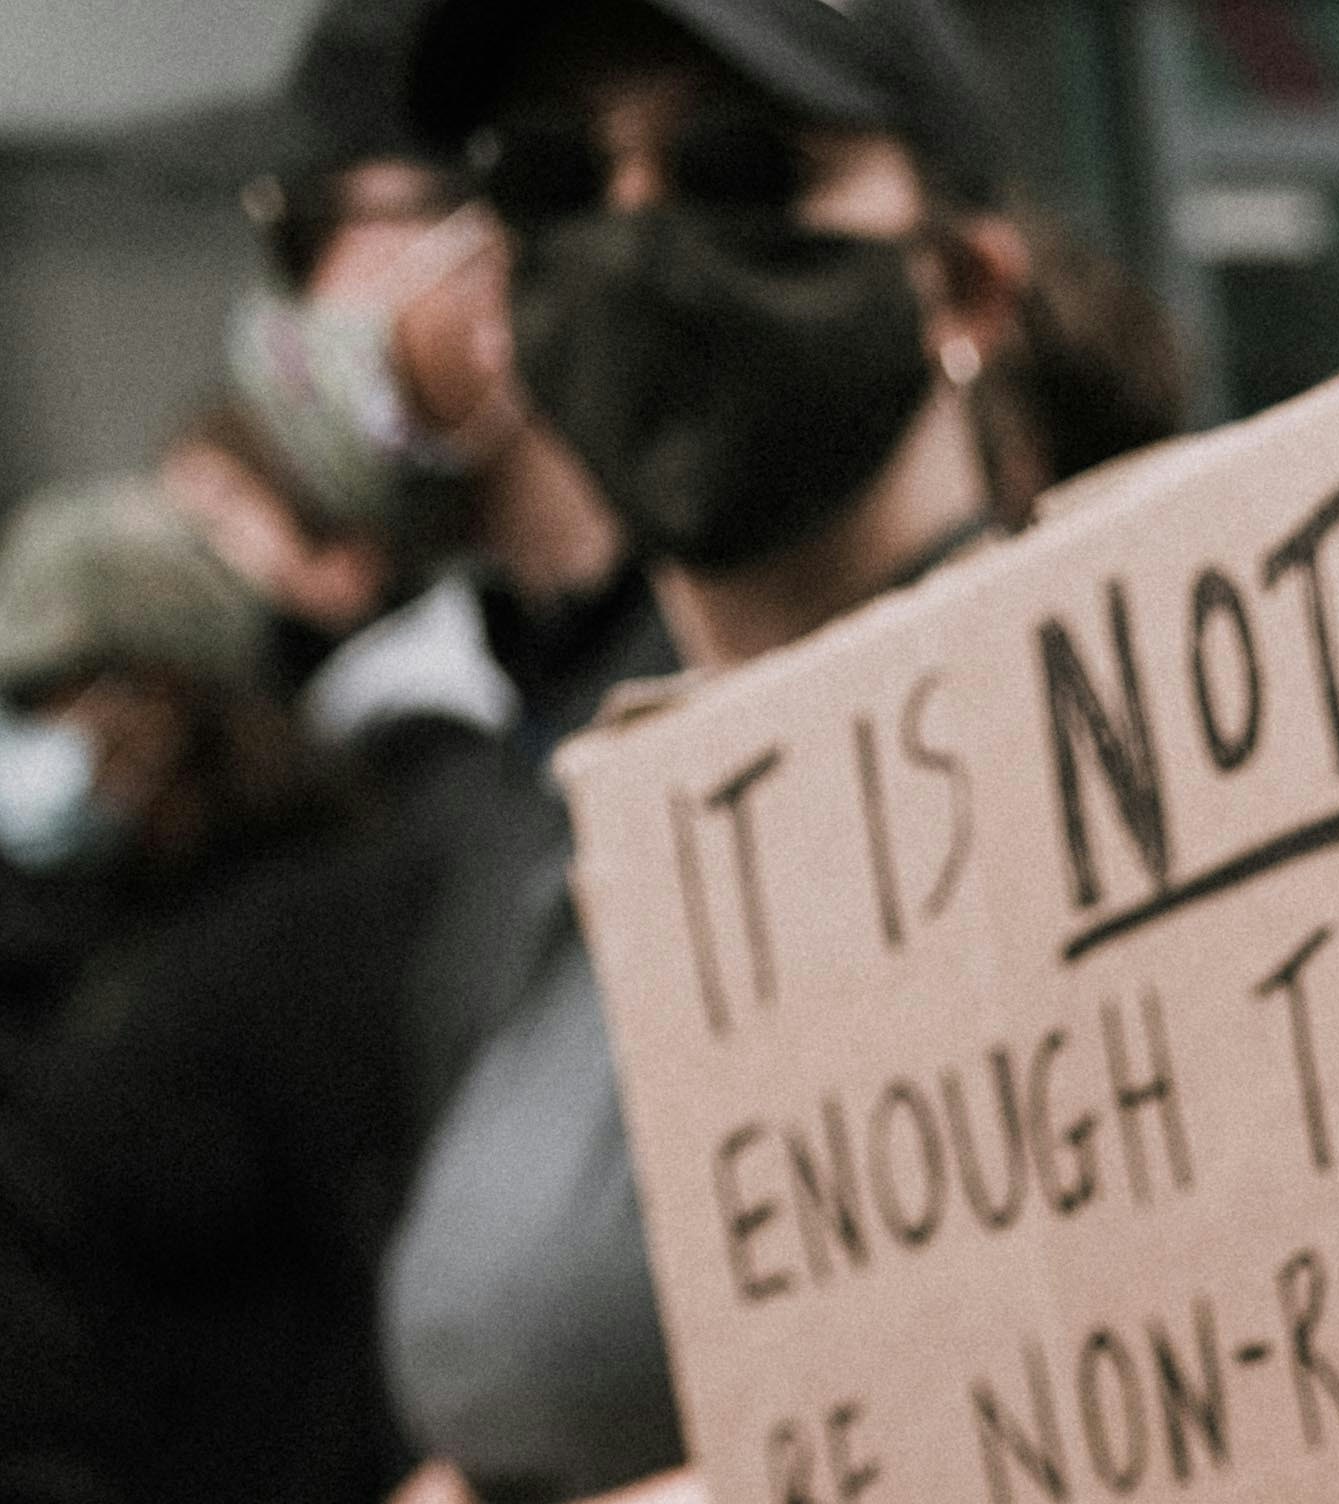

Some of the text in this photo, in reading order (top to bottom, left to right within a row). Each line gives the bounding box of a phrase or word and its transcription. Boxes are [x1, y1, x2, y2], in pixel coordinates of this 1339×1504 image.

[672, 750, 788, 1032] IT
[860, 665, 978, 955] IS
[715, 985, 1195, 1305] ENOUGH
